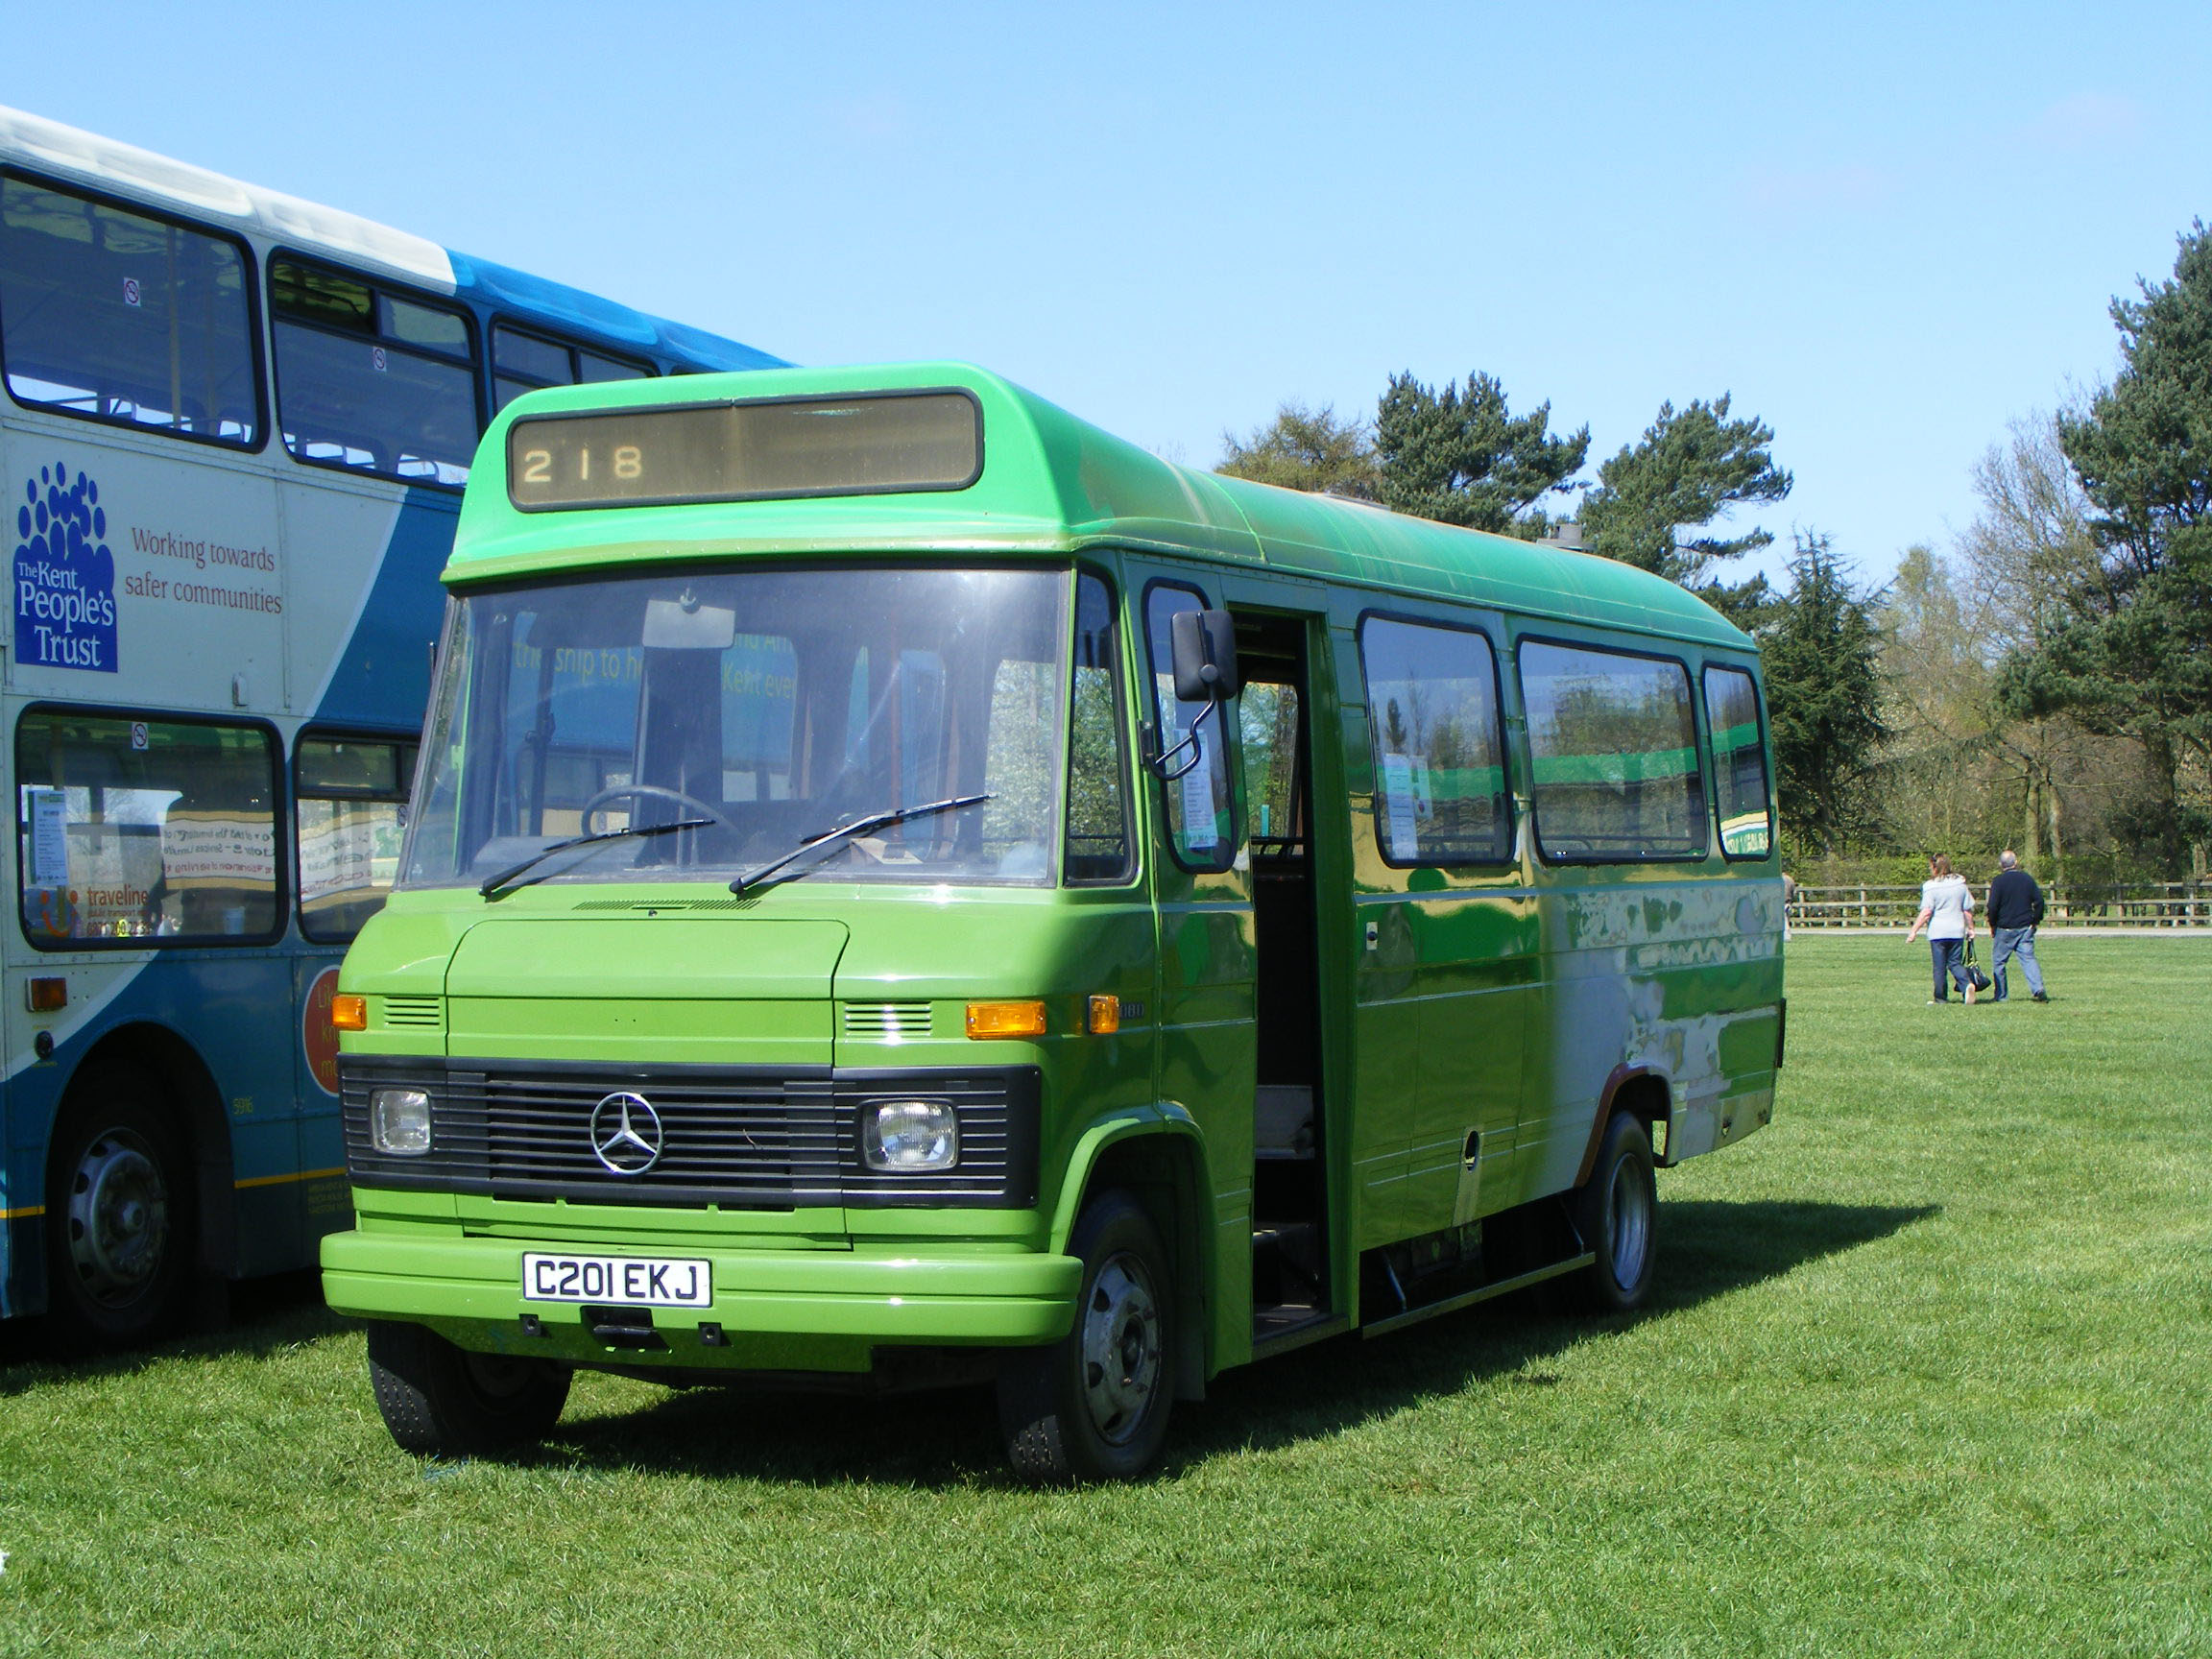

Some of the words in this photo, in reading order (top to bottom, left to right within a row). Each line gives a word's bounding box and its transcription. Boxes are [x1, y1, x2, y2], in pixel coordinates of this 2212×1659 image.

[132, 527, 205, 569] Working
[210, 542, 275, 571] towards
[17, 562, 37, 577] The
[37, 561, 78, 590] Kent
[125, 571, 168, 599] safer
[174, 581, 282, 614] communities
[18, 580, 114, 634] People's
[34, 625, 102, 666] Trust
[599, 647, 620, 680] to
[87, 883, 150, 906] traveline
[535, 1260, 613, 1297] C201
[624, 1263, 697, 1300] EKJ
